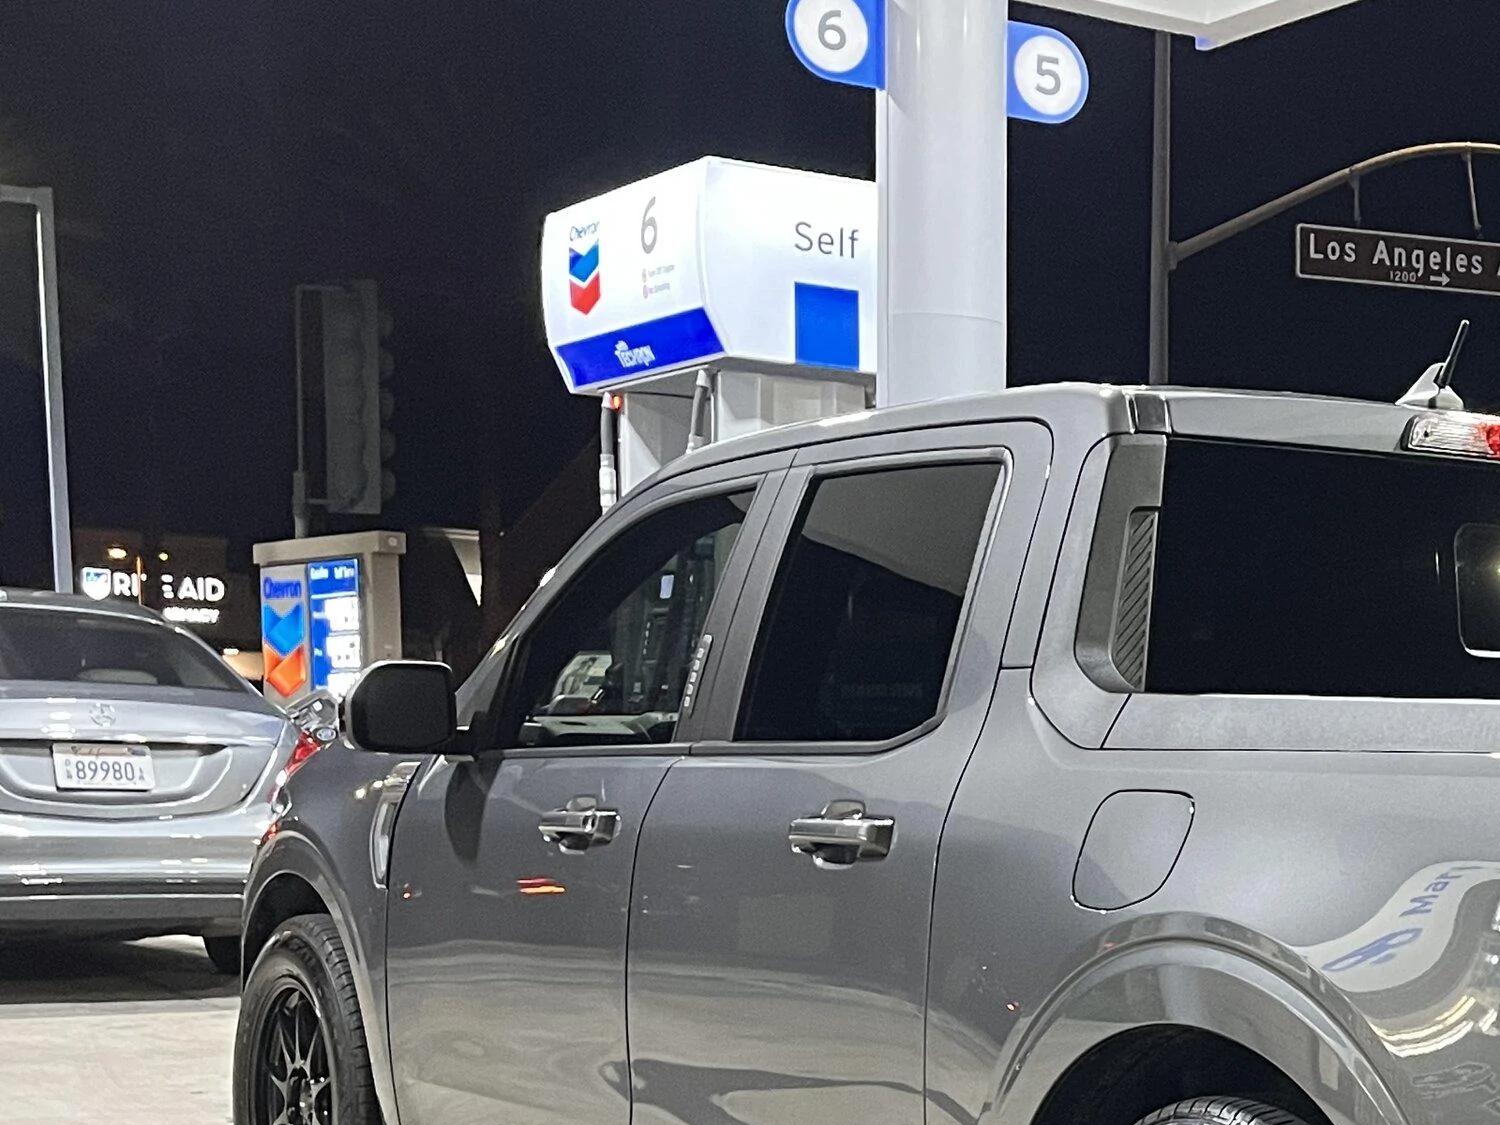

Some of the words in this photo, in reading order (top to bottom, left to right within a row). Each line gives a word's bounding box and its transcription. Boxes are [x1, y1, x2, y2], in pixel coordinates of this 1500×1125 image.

[817, 10, 847, 51] 6
[1035, 54, 1062, 96] 5
[641, 196, 658, 255] 6
[794, 221, 859, 259] Self
[1309, 233, 1357, 263] Los
[1372, 240, 1483, 277] Angeles
[1389, 270, 1417, 283] 1200
[177, 575, 226, 602] AID
[75, 760, 135, 782] 89980
